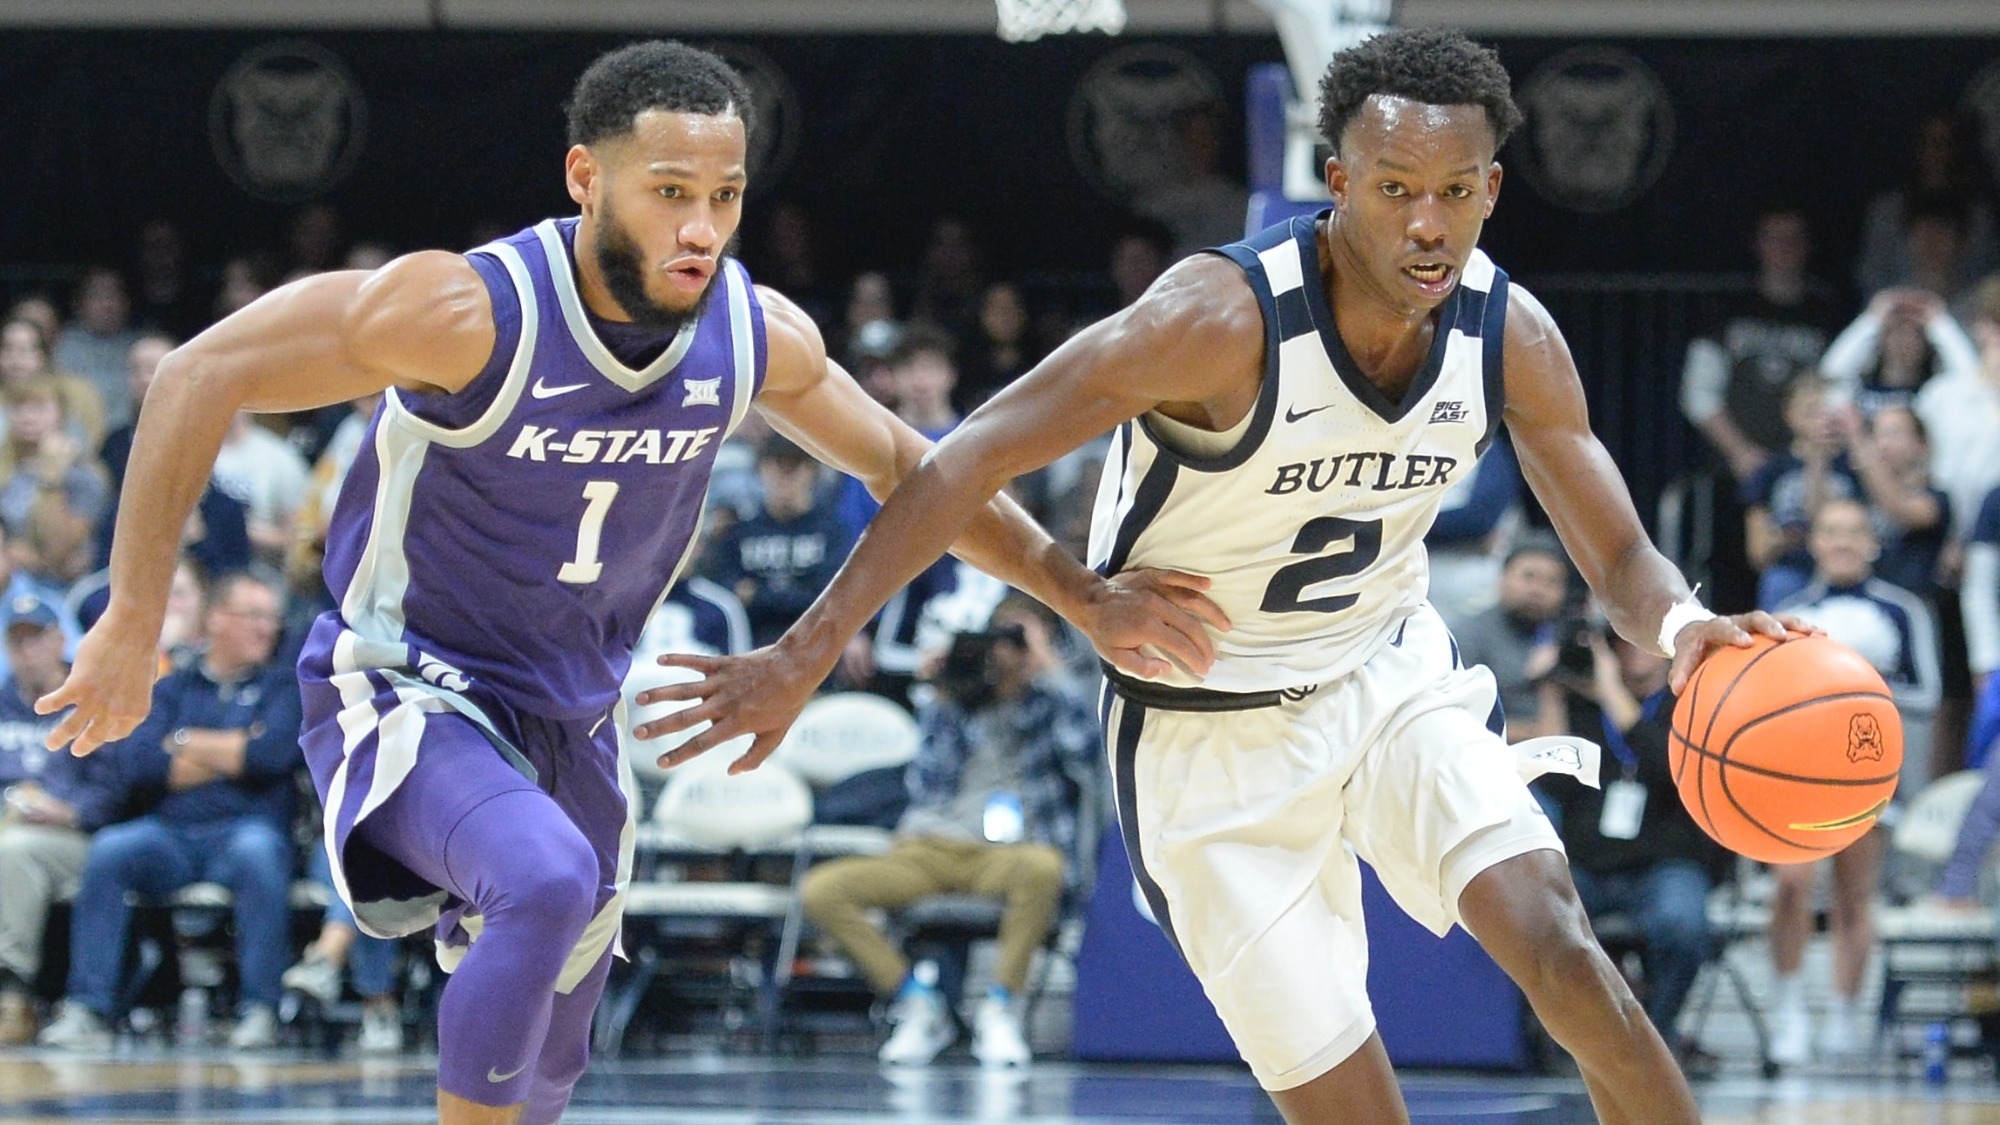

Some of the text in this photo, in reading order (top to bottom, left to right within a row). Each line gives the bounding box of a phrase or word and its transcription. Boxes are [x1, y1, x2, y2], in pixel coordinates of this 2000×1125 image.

[1430, 410, 1470, 420] EAST
[1434, 401, 1464, 411] BIG
[506, 425, 719, 464] K-STATE
[1264, 452, 1457, 495] BUTLER
[557, 481, 619, 584] 1
[1258, 516, 1383, 613] 2
